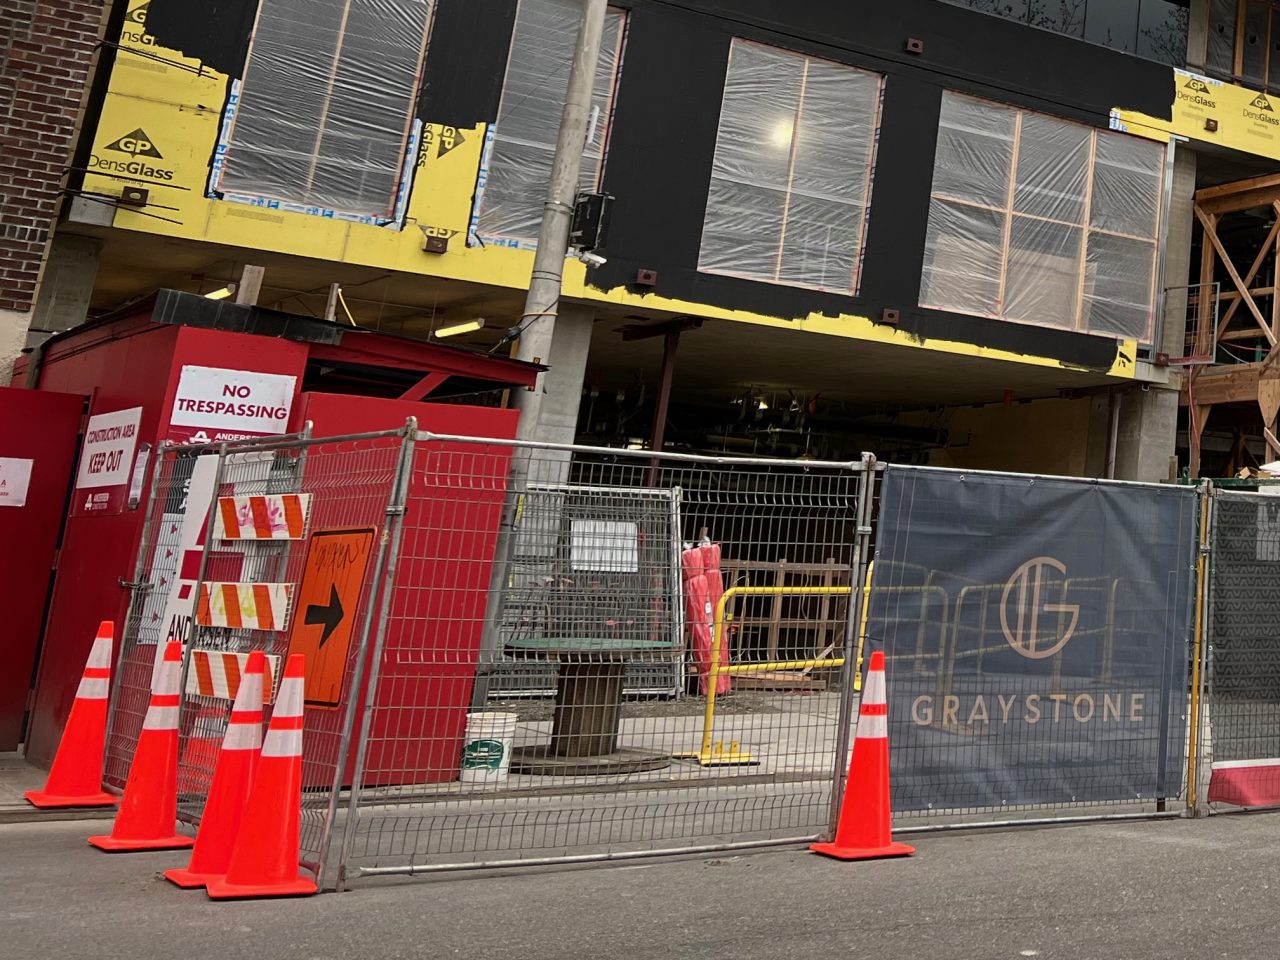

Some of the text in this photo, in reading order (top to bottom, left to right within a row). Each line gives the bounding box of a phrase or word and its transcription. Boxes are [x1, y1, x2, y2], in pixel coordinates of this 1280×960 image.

[1177, 90, 1216, 109] DensGlass
[1255, 98, 1268, 108] GP
[1242, 108, 1280, 126] DensGlass
[118, 137, 152, 153] GP
[87, 154, 175, 181] DensGlass
[222, 384, 251, 399] NO
[178, 398, 288, 420] TRESPASSING
[88, 450, 124, 474] KEEP OUT
[911, 693, 1146, 726] GRAYSTONE
